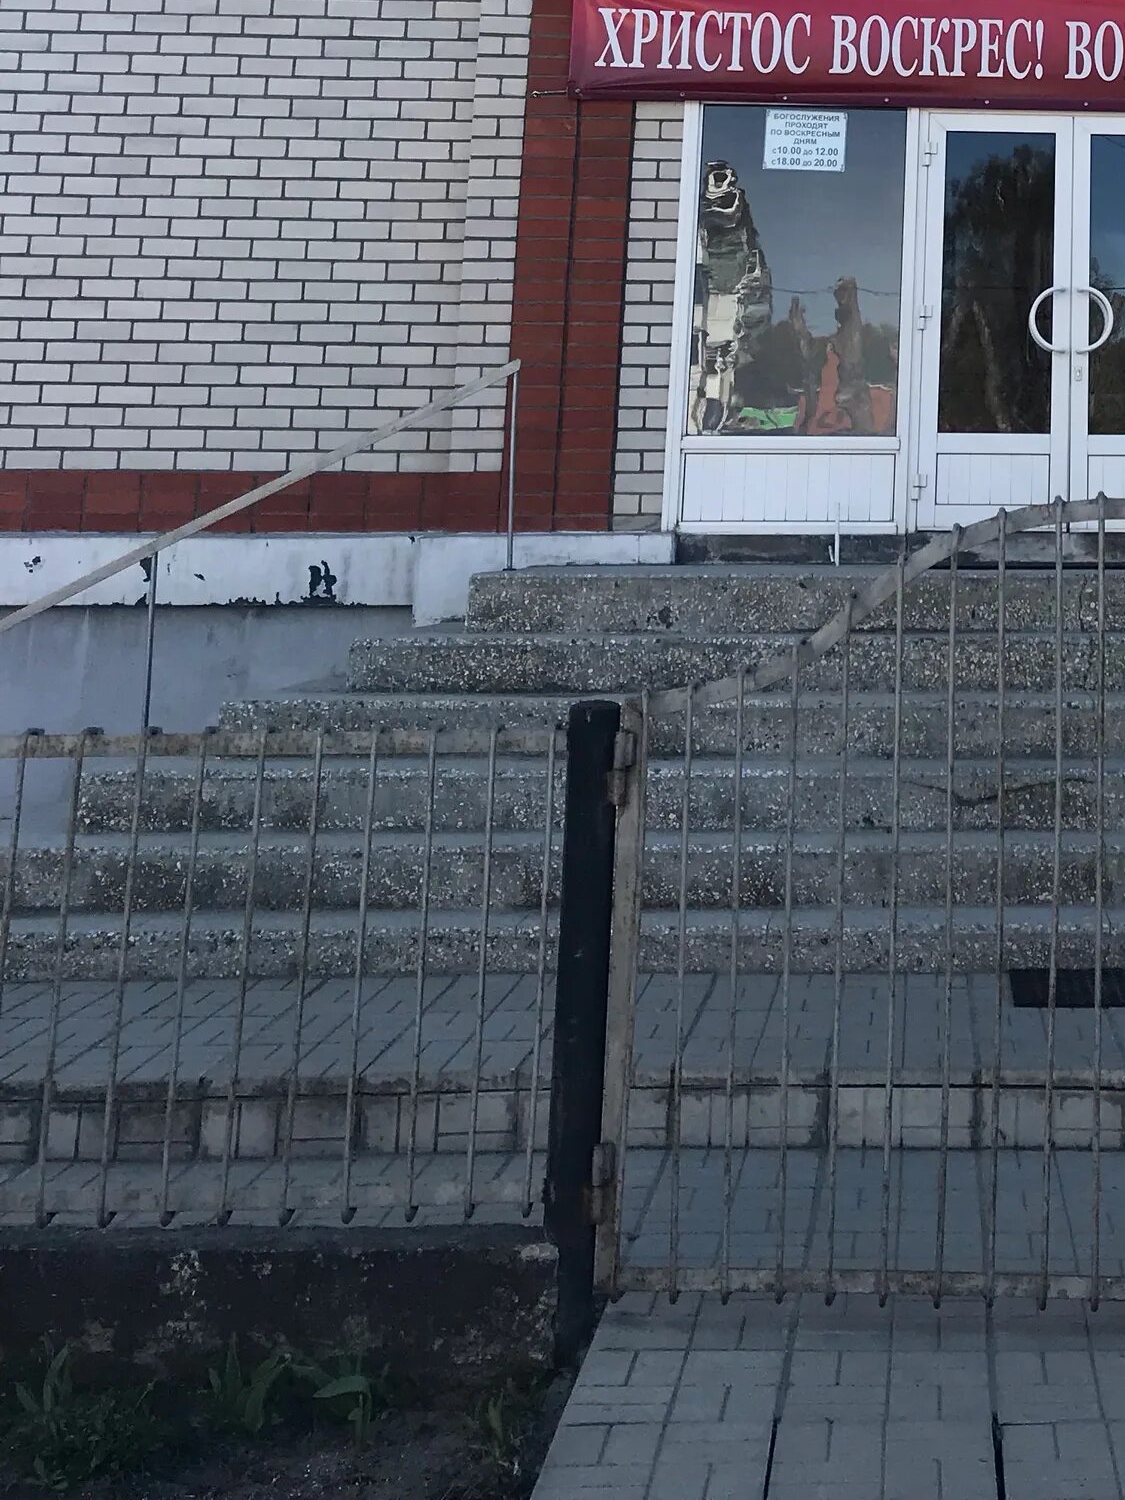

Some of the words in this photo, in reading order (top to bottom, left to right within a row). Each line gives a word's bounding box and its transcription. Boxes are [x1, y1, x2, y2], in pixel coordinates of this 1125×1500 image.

[593, 7, 811, 75] ХРИСТОС
[828, 14, 1046, 80] ВОСКРЕС!
[773, 113, 840, 121] БОГОСЛУЖЕНИЯ
[785, 121, 828, 129] ПРОХОДЯТ
[815, 148, 839, 156] 12.00
[814, 158, 838, 167] 20.00
